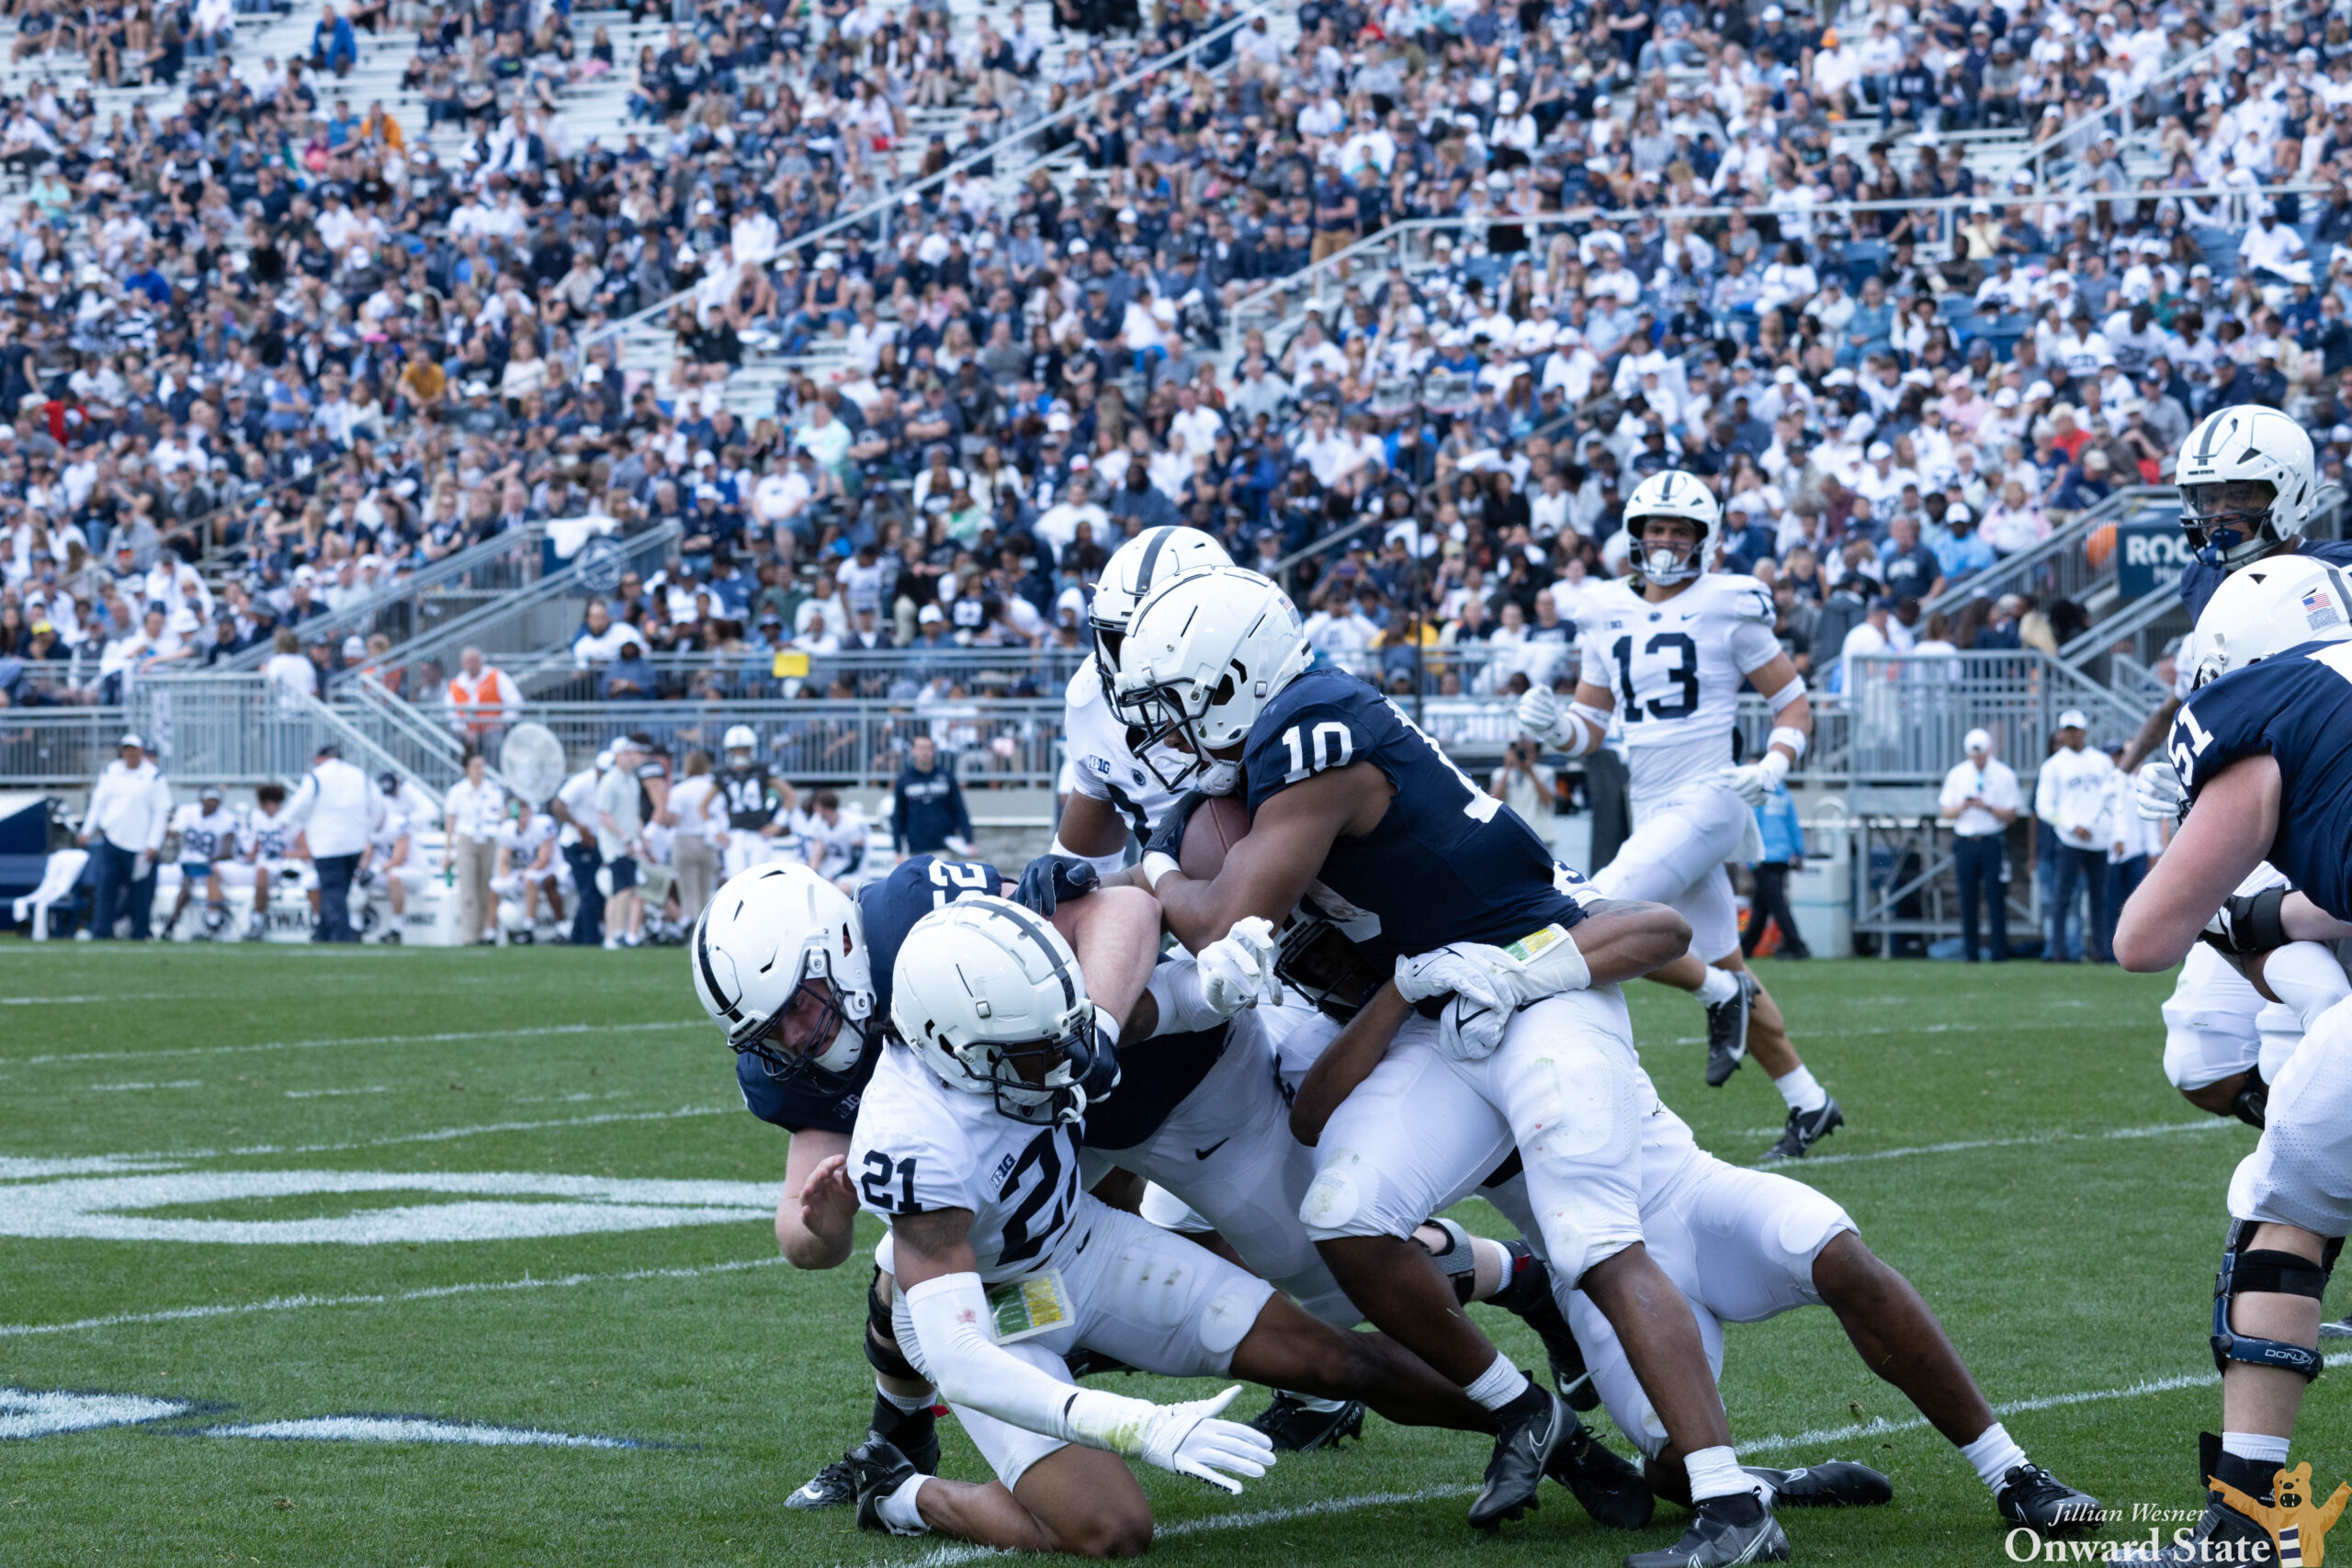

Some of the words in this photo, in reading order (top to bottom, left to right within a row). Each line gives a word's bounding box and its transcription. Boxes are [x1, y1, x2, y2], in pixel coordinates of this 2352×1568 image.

[1612, 633, 1699, 723] 13
[1282, 721, 1353, 784] 10
[2168, 702, 2214, 786] 51
[727, 778, 763, 814] 14
[861, 1149, 922, 1213] 21
[2265, 1348, 2315, 1365] DONJOY
